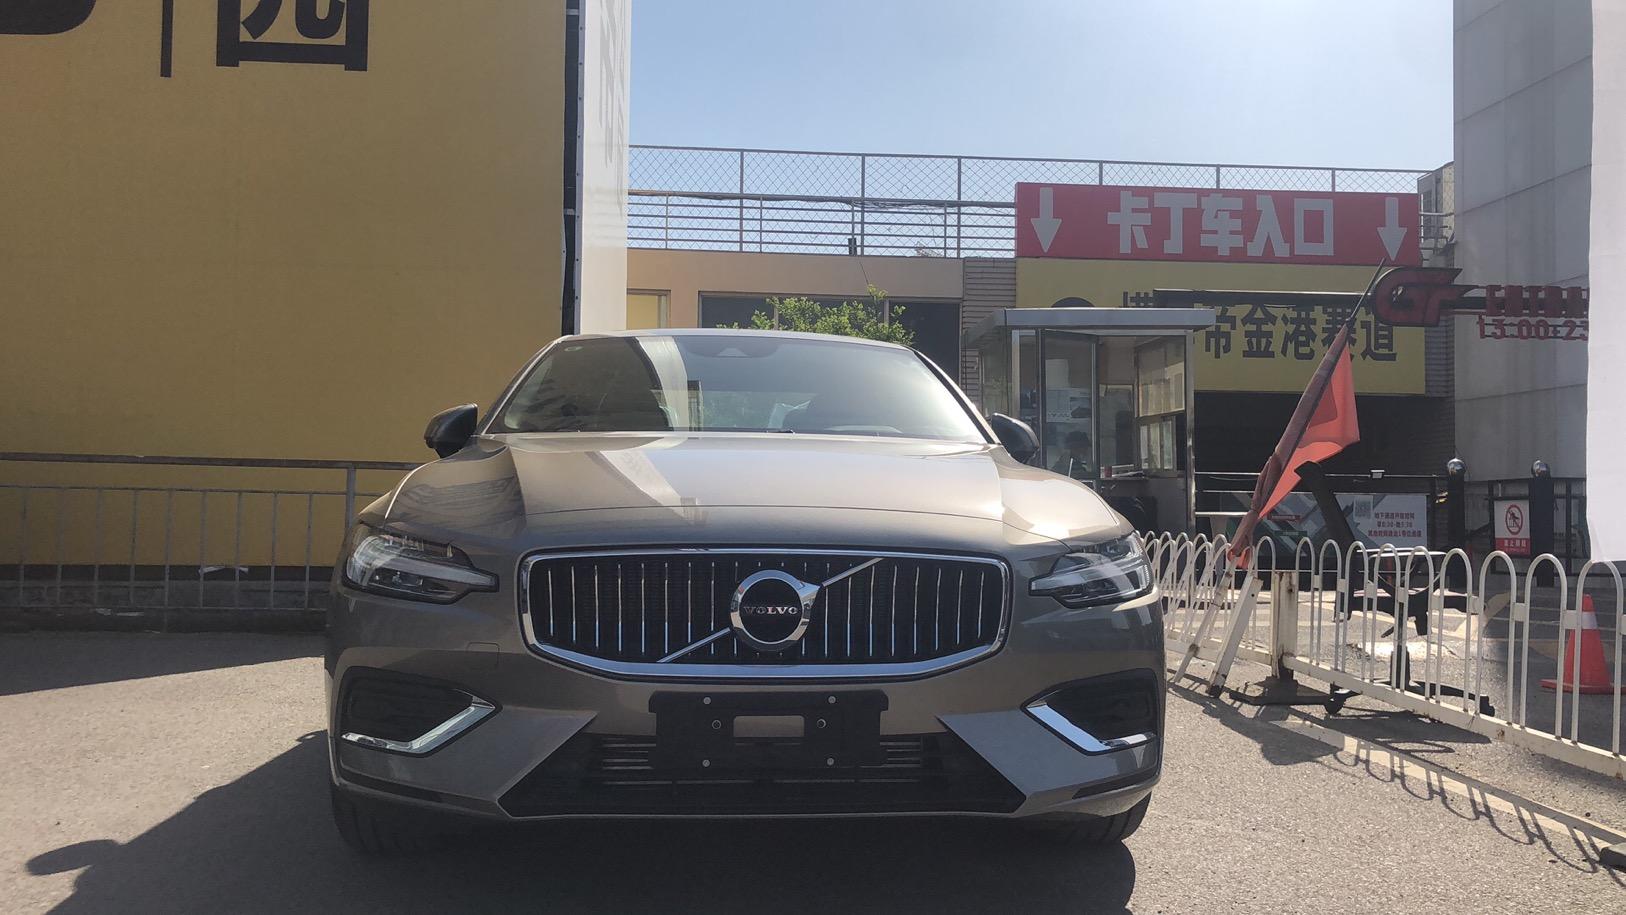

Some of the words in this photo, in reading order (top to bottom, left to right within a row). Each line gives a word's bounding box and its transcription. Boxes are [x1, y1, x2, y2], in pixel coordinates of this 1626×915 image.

[1107, 191, 1334, 257] 卡丁车入口
[743, 606, 798, 615] VOLVO
